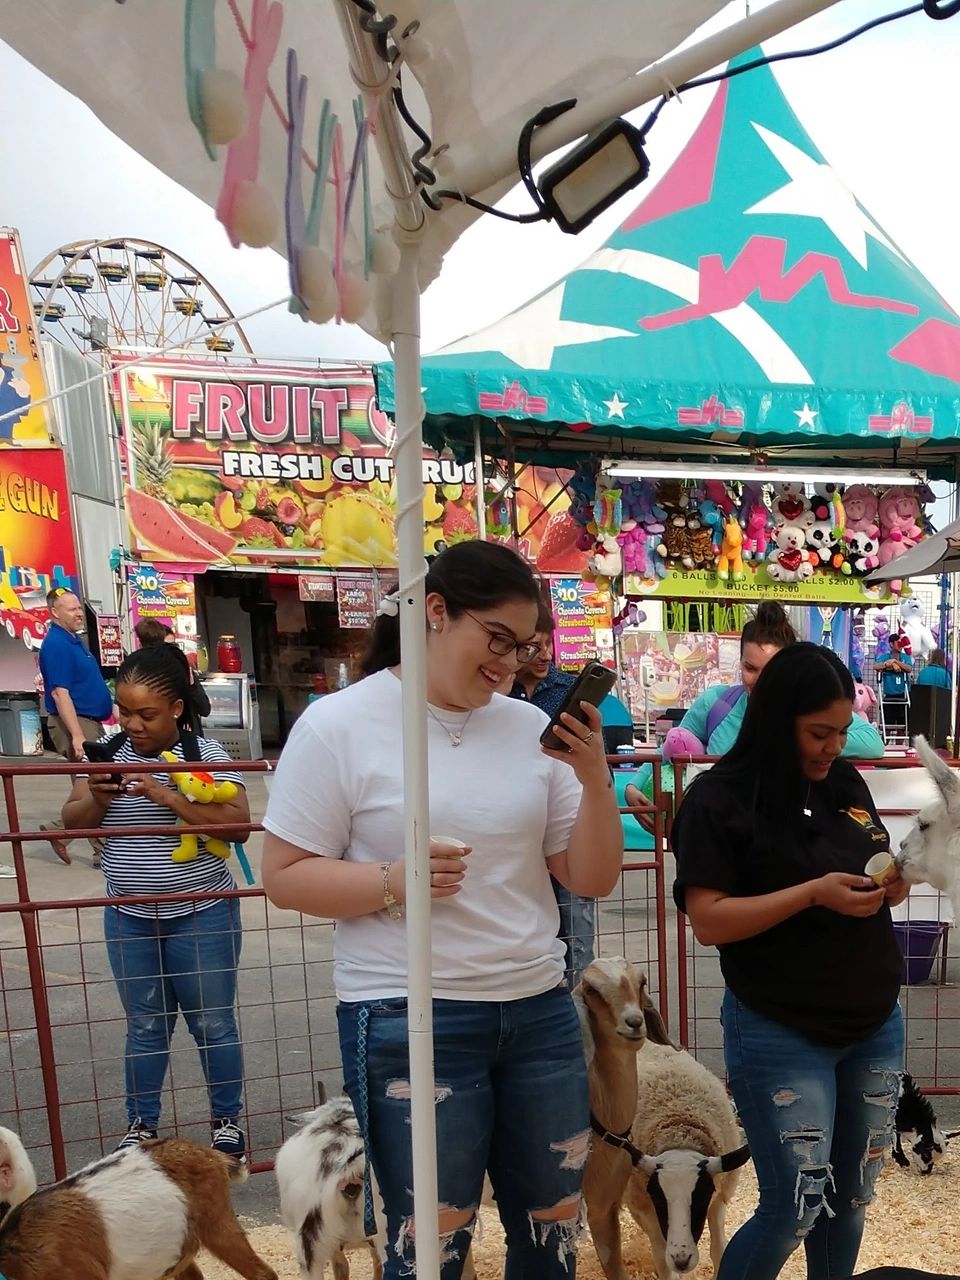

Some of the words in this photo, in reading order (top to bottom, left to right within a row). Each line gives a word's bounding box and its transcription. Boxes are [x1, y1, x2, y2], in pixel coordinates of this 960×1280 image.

[172, 379, 348, 445] FRUIT
[223, 451, 323, 480] FRESH
[332, 456, 394, 482] CUT
[421, 459, 490, 485] RUI
[7, 472, 59, 522] GUN
[682, 572, 716, 580] BALLS
[828, 578, 855, 586] $2.00
[726, 583, 770, 591] BUCKET
[773, 585, 799, 593] $5.00
[557, 588, 578, 602] $10
[558, 607, 585, 615] Chocolate
[585, 606, 607, 615] Covered
